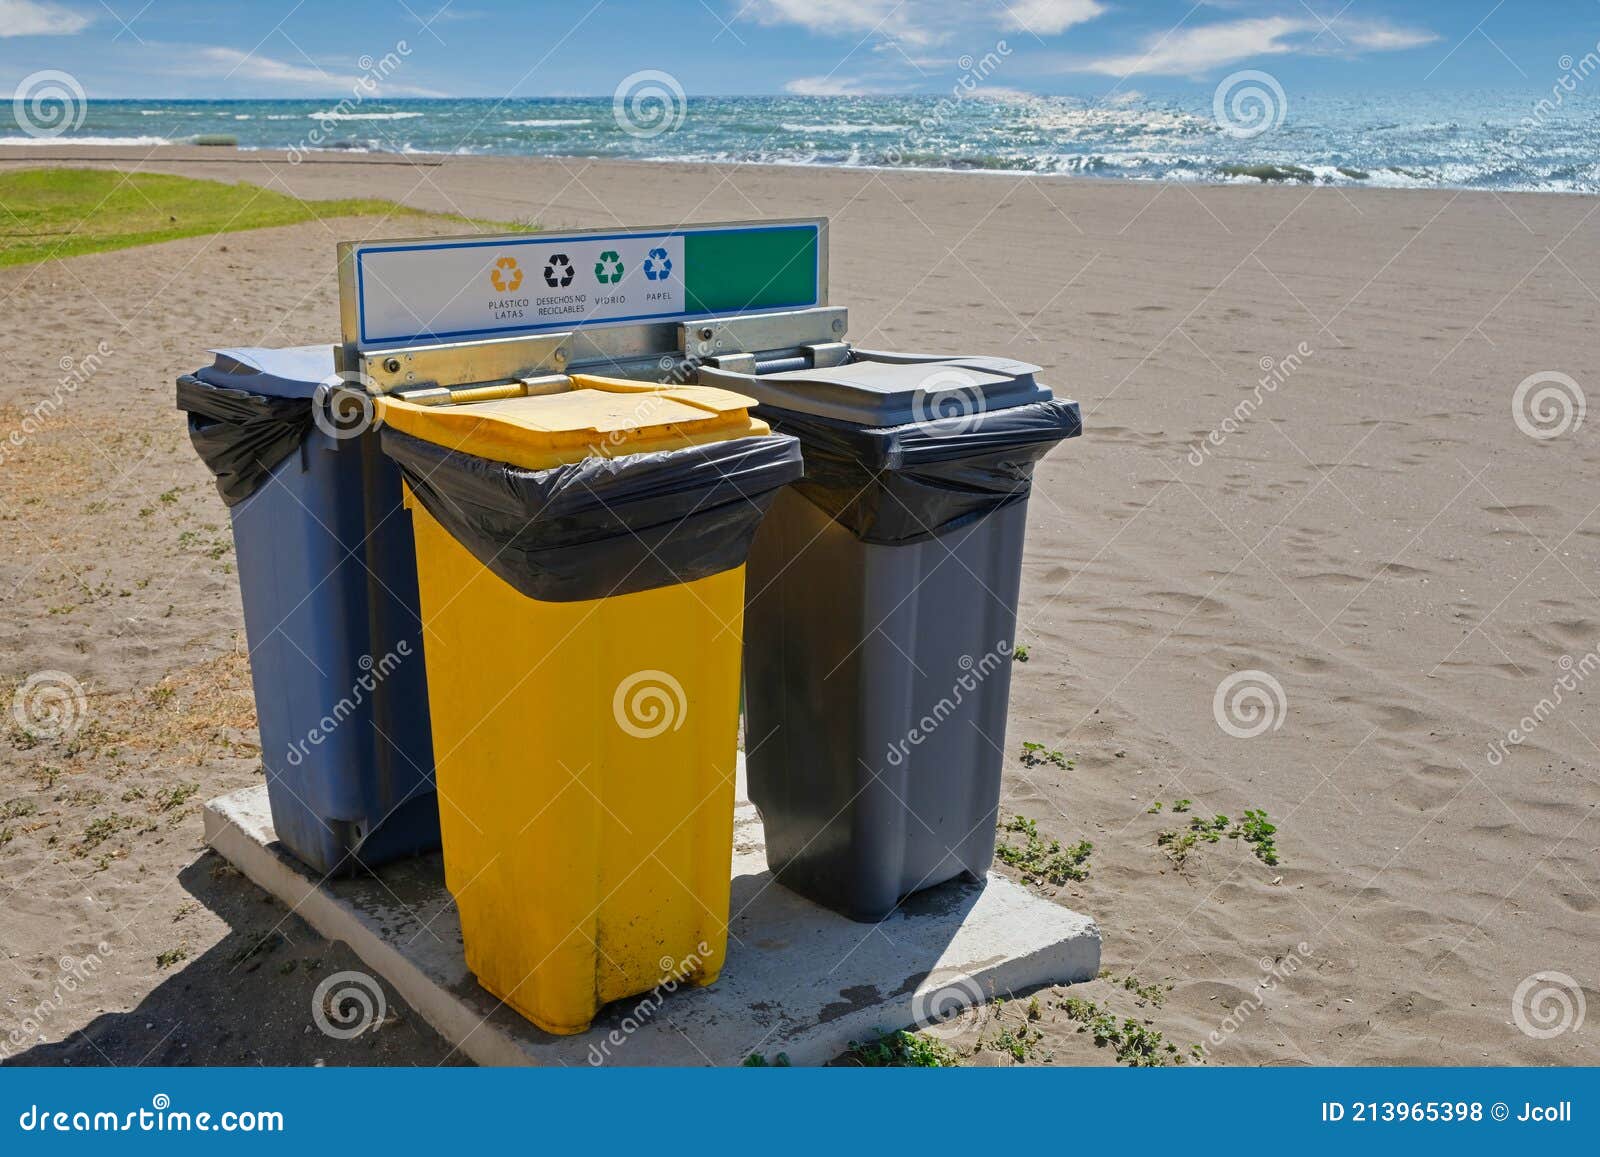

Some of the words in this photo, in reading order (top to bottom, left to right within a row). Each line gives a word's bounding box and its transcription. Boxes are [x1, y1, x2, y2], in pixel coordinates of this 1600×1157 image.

[536, 296, 573, 305] DESECHOS
[575, 295, 586, 303] NO
[594, 295, 626, 305] VIDRIO
[646, 292, 672, 301] PAPEL
[495, 310, 524, 320] LATAS
[538, 305, 585, 315] RECICLABLES
